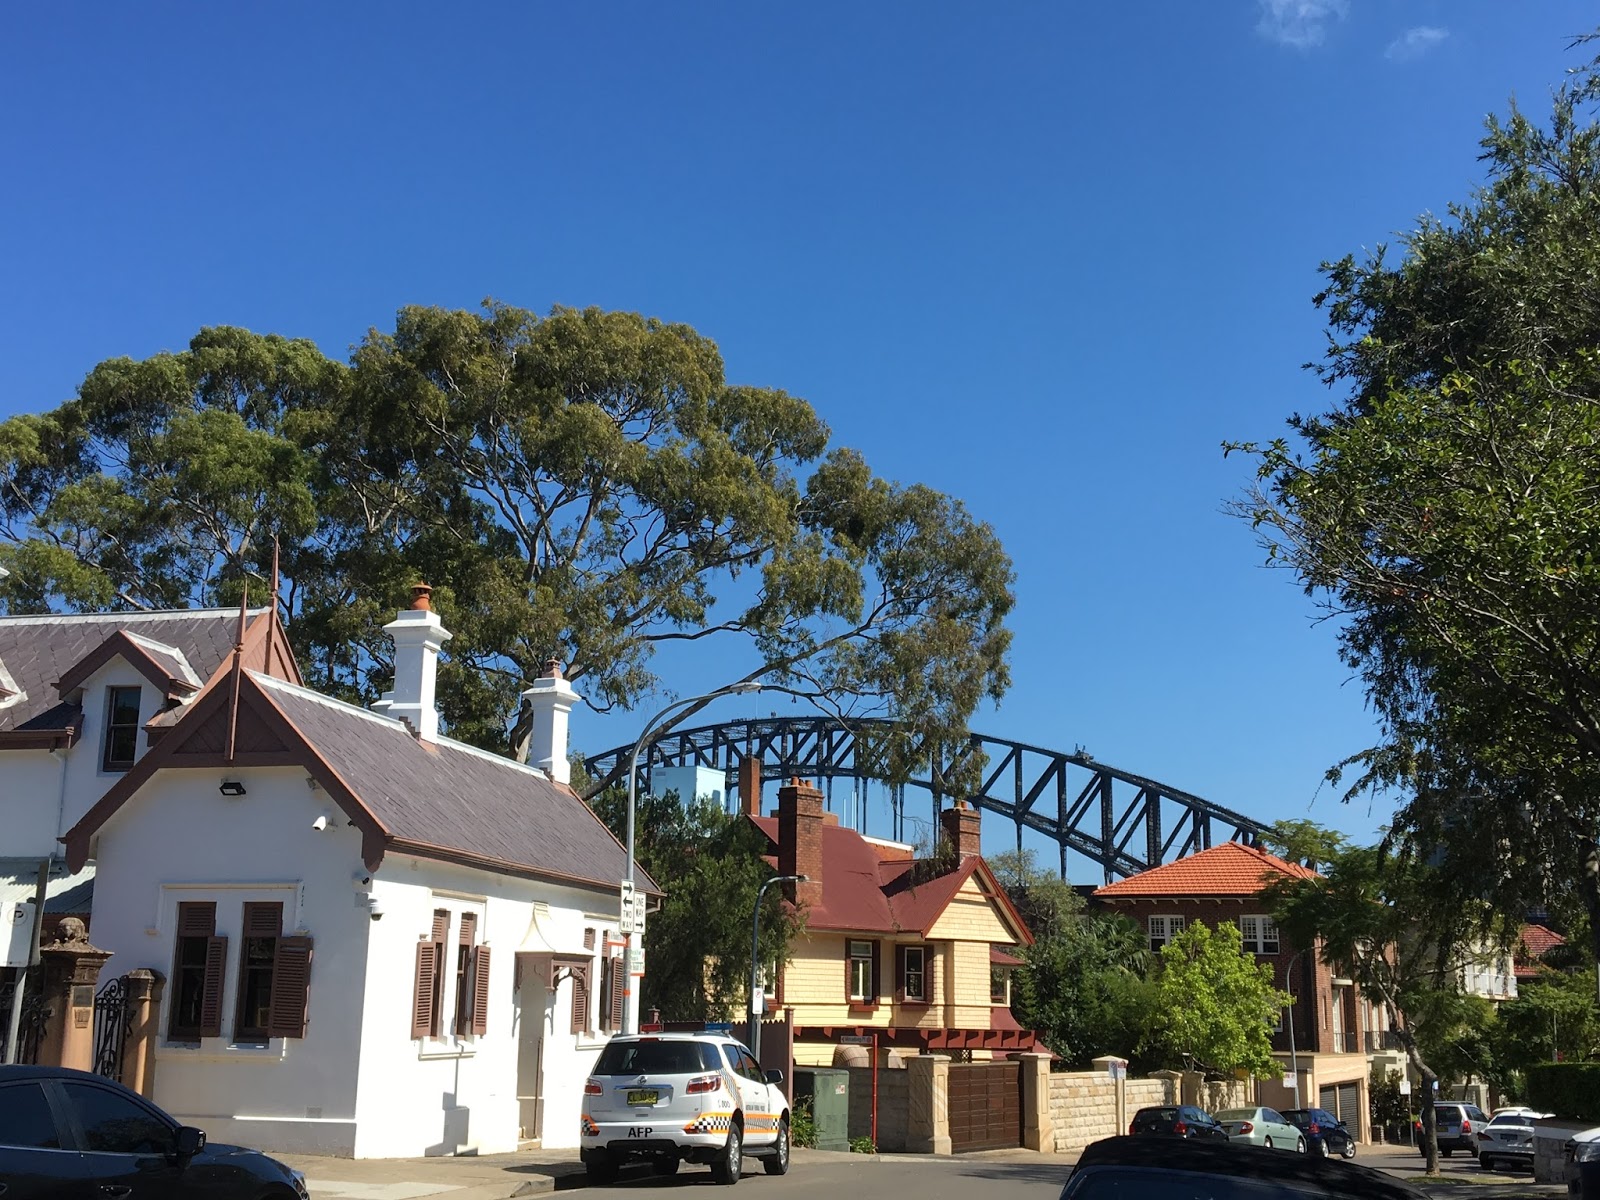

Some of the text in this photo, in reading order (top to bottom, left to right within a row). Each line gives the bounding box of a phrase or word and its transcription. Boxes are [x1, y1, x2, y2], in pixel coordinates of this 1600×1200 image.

[635, 897, 644, 907] ONE
[622, 910, 632, 918] TWO
[635, 909, 644, 918] WAY
[622, 921, 633, 929] WAY
[628, 1127, 653, 1138] AFP
